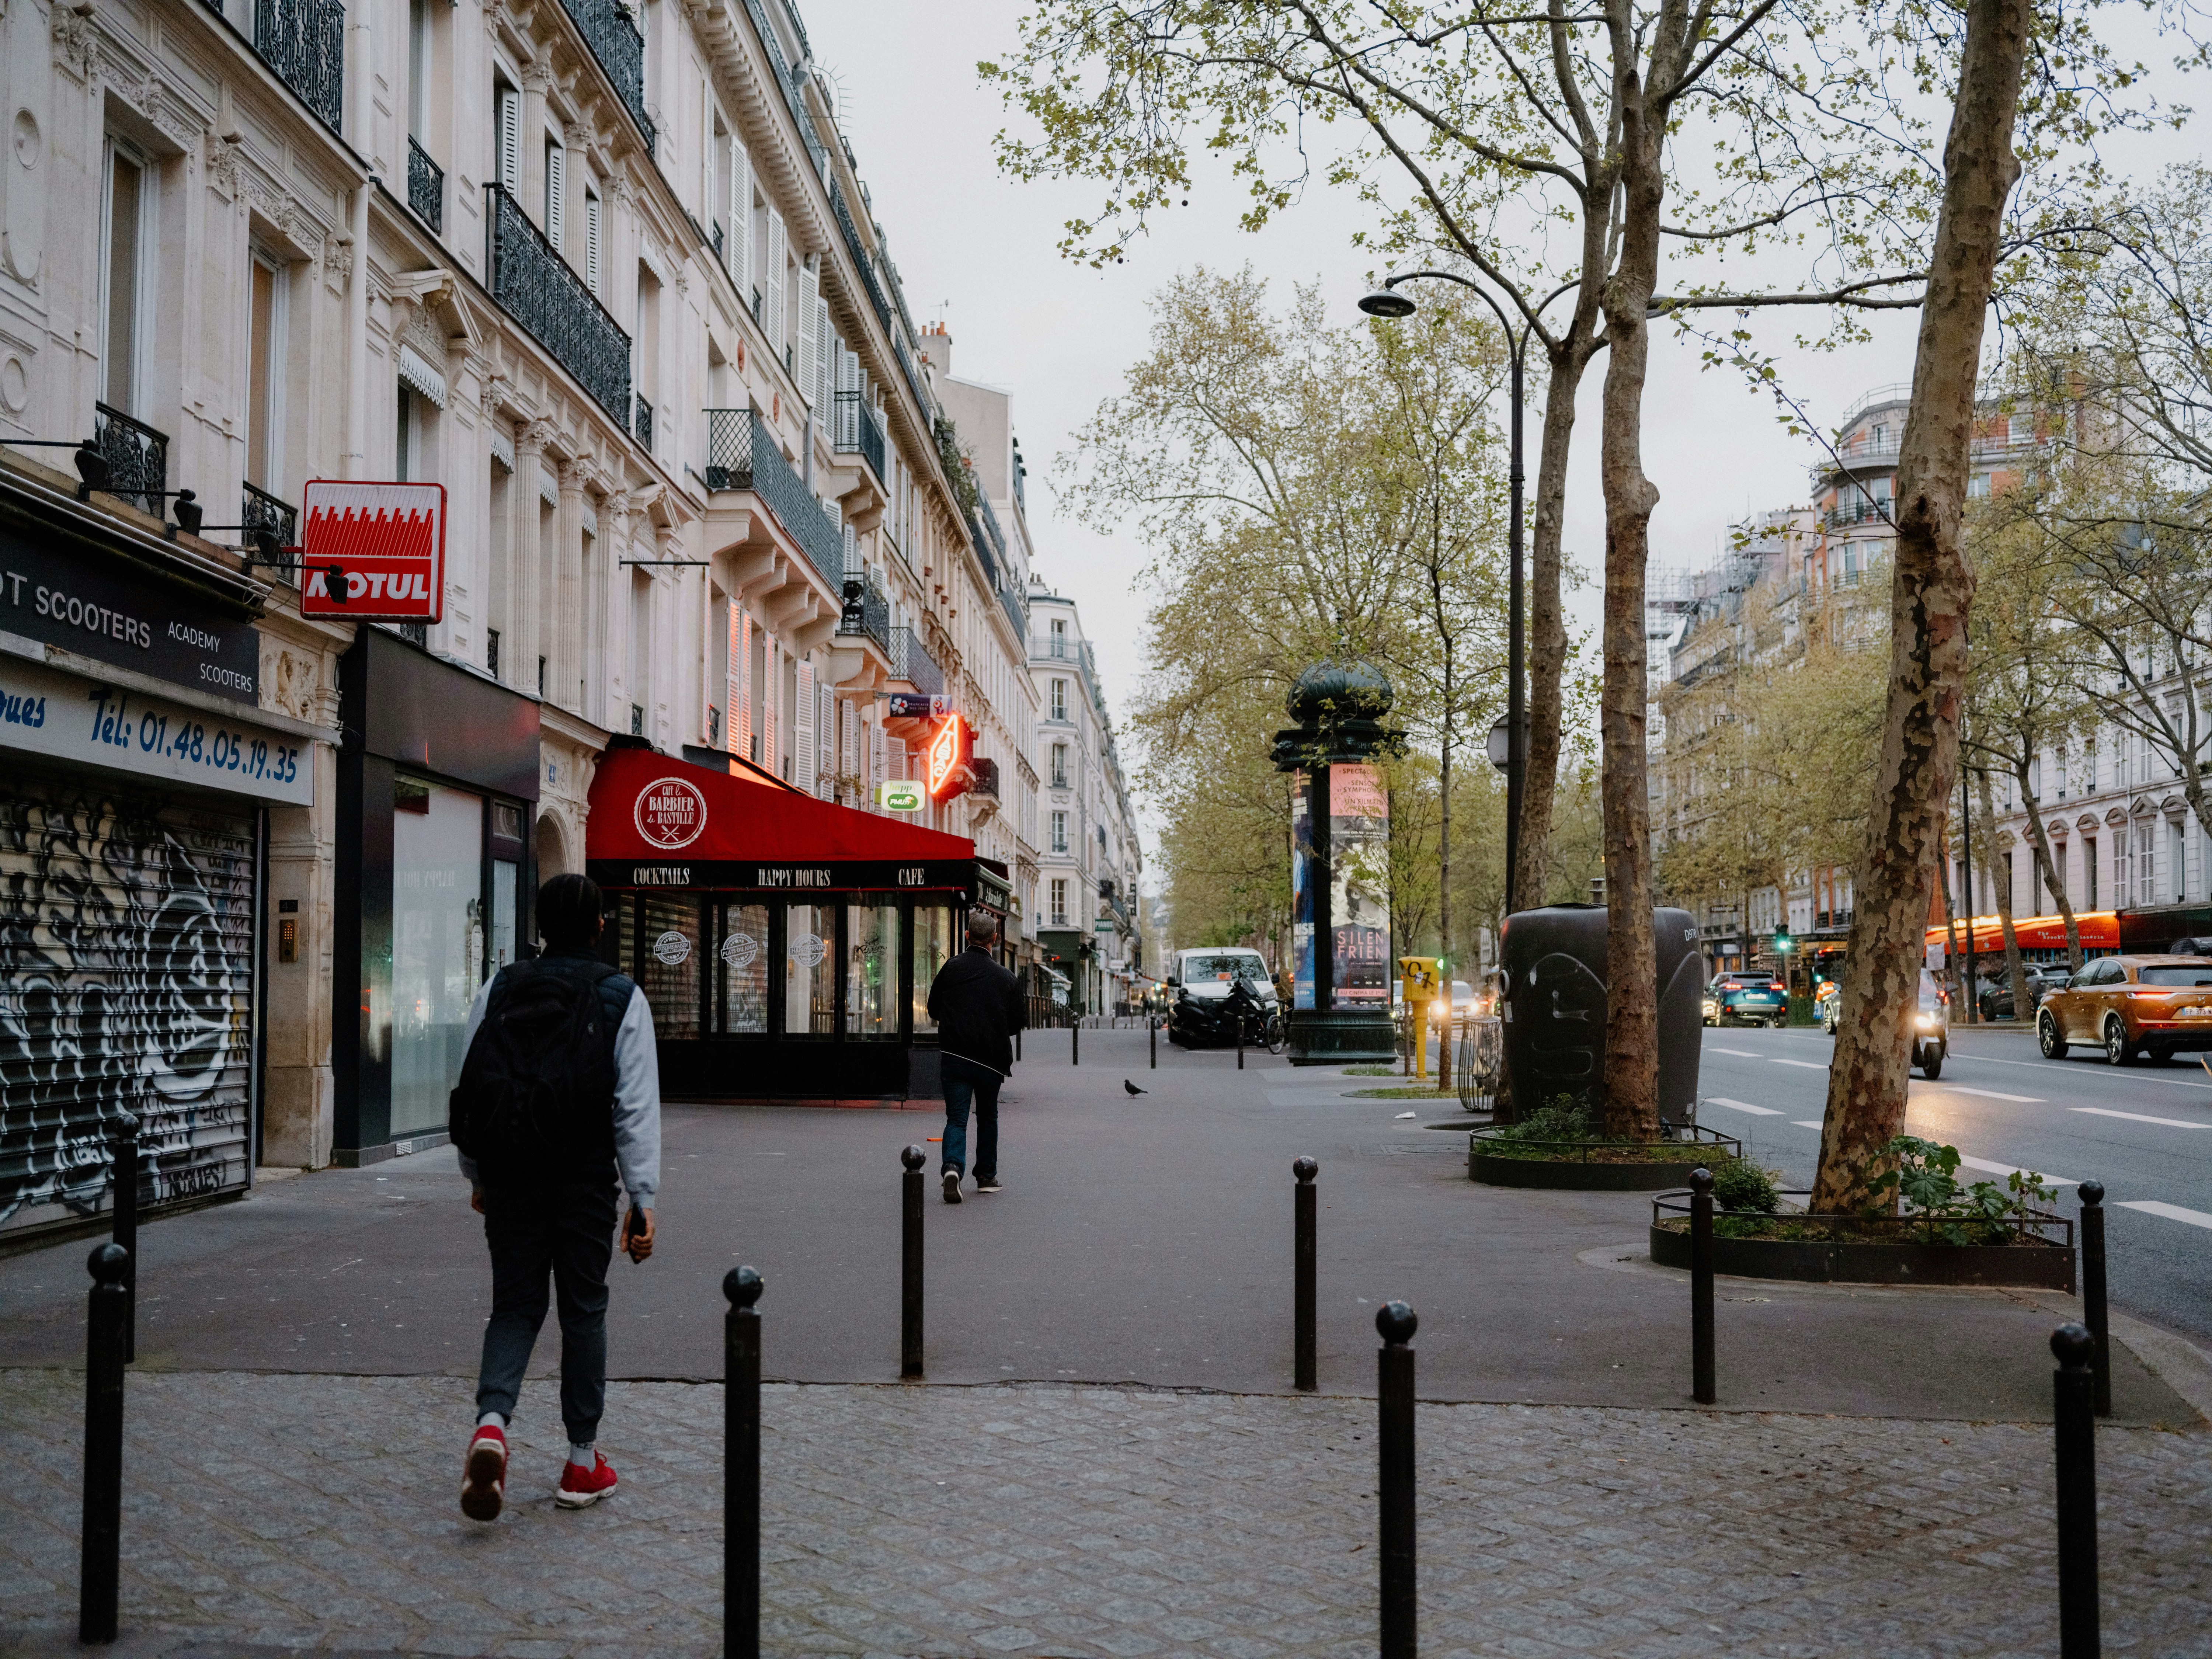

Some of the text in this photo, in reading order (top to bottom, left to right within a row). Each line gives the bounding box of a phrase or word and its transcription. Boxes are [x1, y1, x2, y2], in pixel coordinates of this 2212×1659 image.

[306, 572, 429, 599] MOTUL
[0, 571, 151, 648] T SCOOTERS
[168, 622, 220, 653] ACADEMY
[200, 663, 252, 692] SCOOTERS
[88, 684, 131, 748] Tél:
[140, 711, 298, 783] 01.48.05.19.35
[933, 730, 954, 777] TABAC
[662, 785, 682, 796] CAFE le
[649, 796, 694, 811] BARBIER
[647, 811, 694, 824] de BASTILLE
[634, 868, 924, 886] COCKTAILS HAPPY HOURS CAFE
[1684, 928, 1697, 941] D970
[745, 943, 756, 952] JOUR
[1338, 945, 1384, 959] FRIEN
